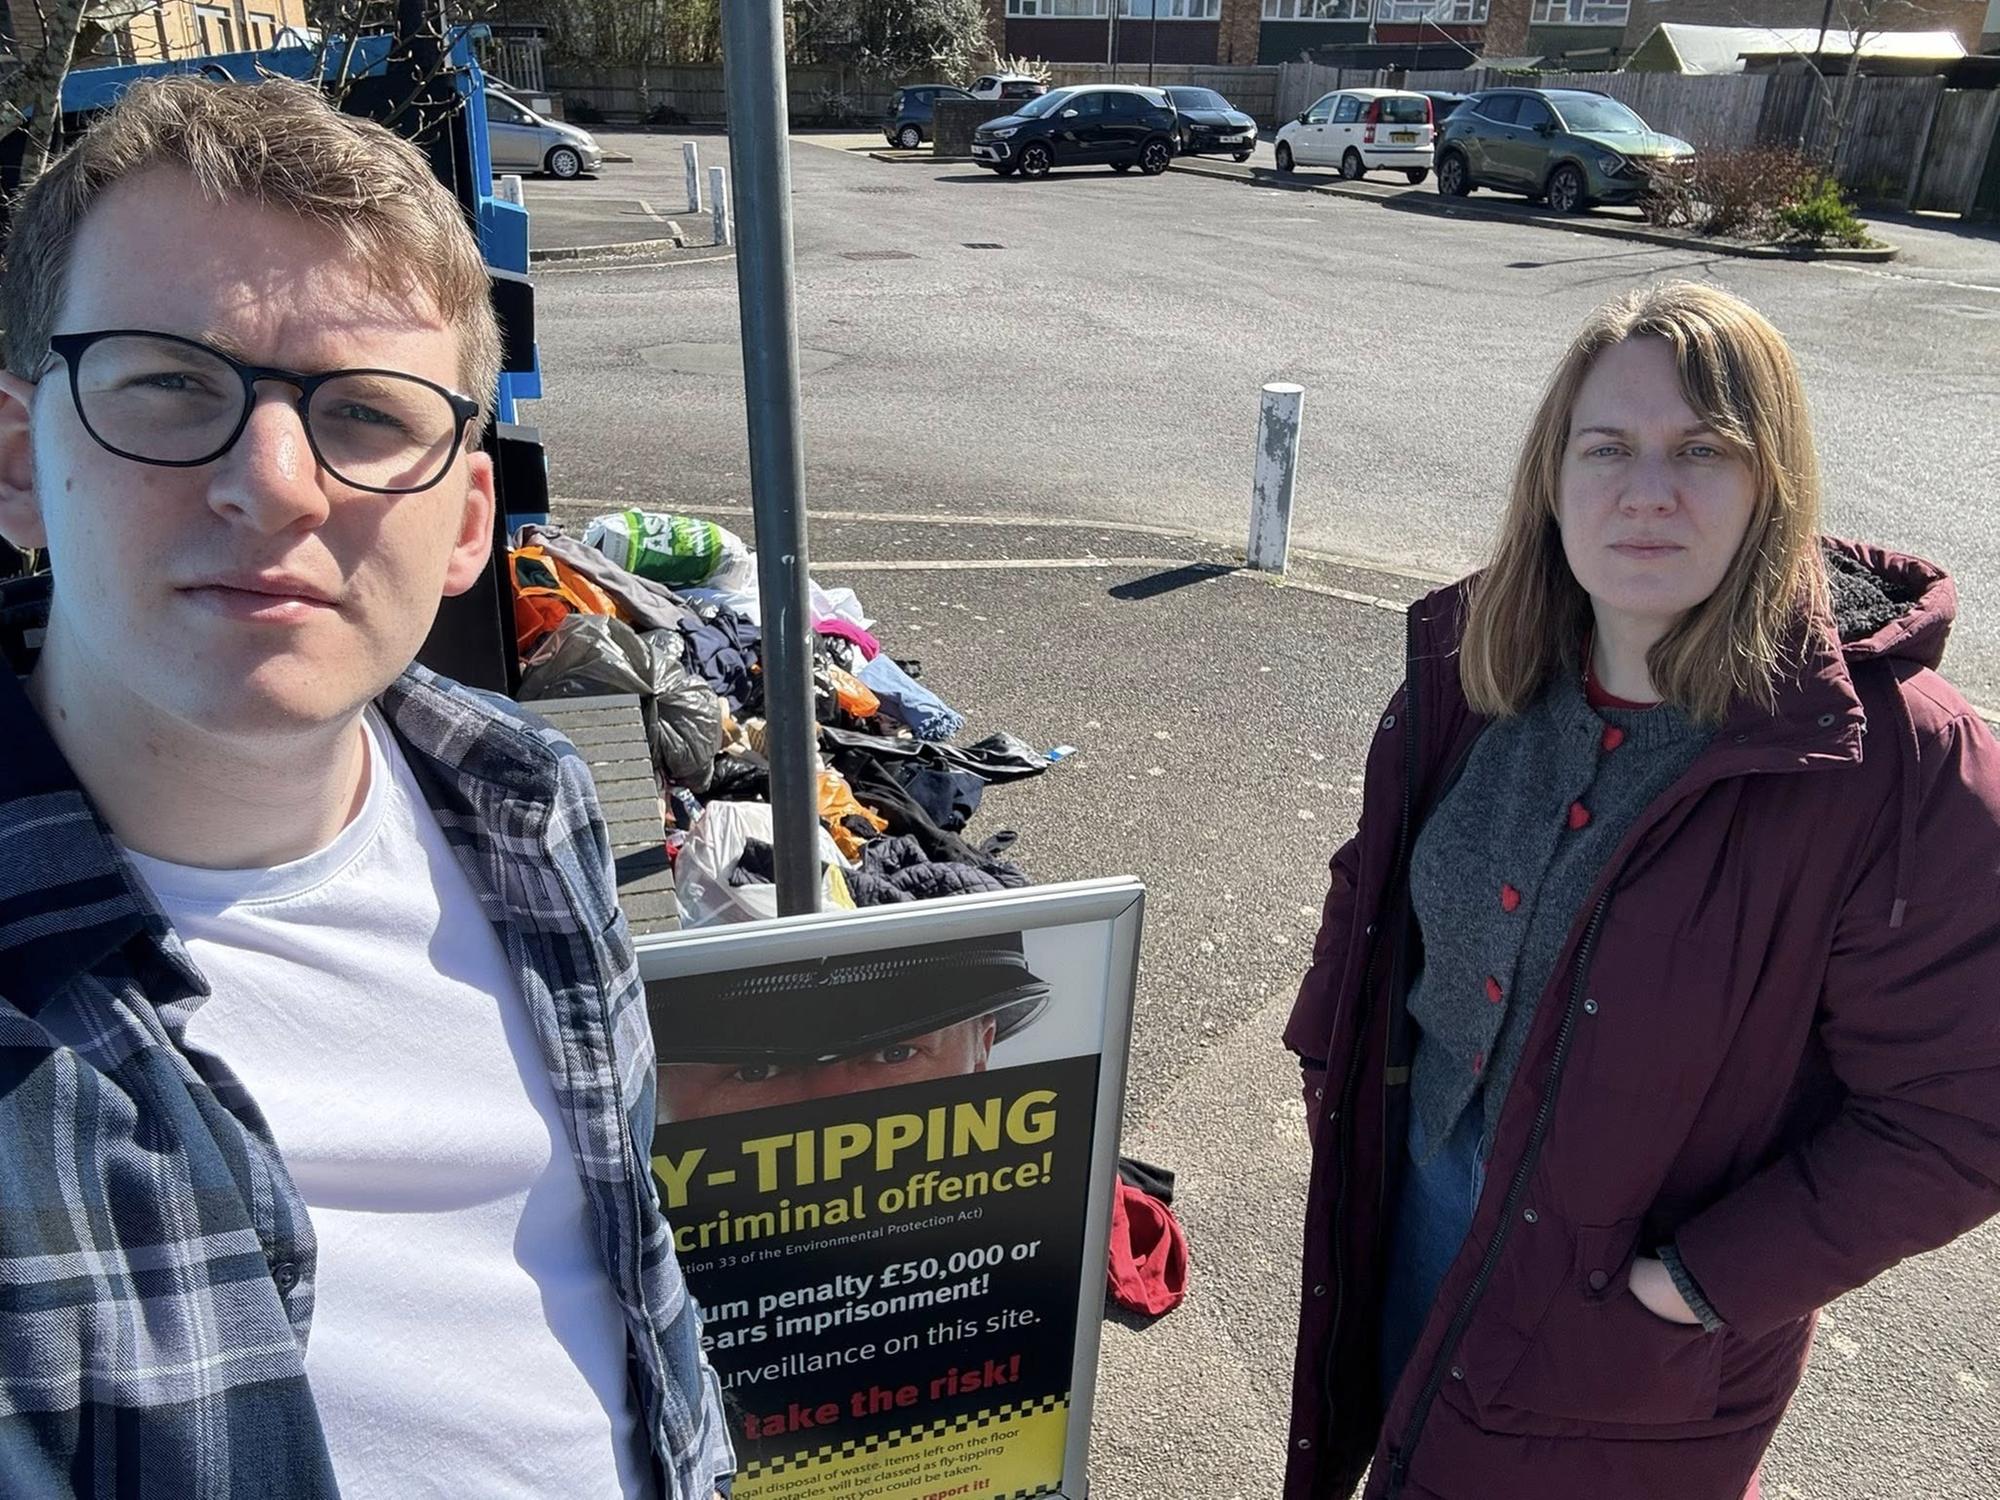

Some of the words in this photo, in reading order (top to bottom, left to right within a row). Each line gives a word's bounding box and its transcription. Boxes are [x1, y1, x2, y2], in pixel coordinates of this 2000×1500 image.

[651, 1090, 1058, 1209] Y-TIPPING
[675, 1184, 866, 1252] criminal
[878, 1151, 1053, 1213] offence!
[719, 1256, 737, 1269] 33
[741, 1251, 755, 1264] of
[759, 1248, 782, 1261] the
[786, 1226, 884, 1256] Environmental
[888, 1215, 954, 1235] Protection
[958, 1207, 983, 1221] Act)
[701, 1300, 748, 1323] um
[759, 1274, 873, 1319] penalty
[880, 1244, 1004, 1288] £50,000
[1011, 1240, 1041, 1261] or
[701, 1325, 767, 1351] ears
[776, 1273, 990, 1337] imprisonment!
[884, 1334, 919, 1355] on
[927, 1319, 978, 1345] this
[986, 1308, 1041, 1333] site.
[743, 1402, 840, 1440] take
[851, 1383, 919, 1418] the
[930, 1354, 1021, 1400] risk!
[766, 1473, 820, 1493] disposal
[824, 1469, 840, 1480] of
[841, 1462, 882, 1476] waste.
[885, 1452, 920, 1467] Items
[923, 1446, 945, 1457] left
[947, 1443, 964, 1452] on
[967, 1437, 988, 1448] the
[991, 1429, 1019, 1442] floor
[829, 1478, 851, 1492] will
[855, 1475, 871, 1486] be
[874, 1463, 920, 1482] classed
[923, 1460, 937, 1470] as
[940, 1445, 1004, 1467] fly-tipping
[859, 1486, 883, 1500] you
[886, 1476, 922, 1491] could
[925, 1473, 941, 1483] be
[944, 1463, 982, 1478] taken.
